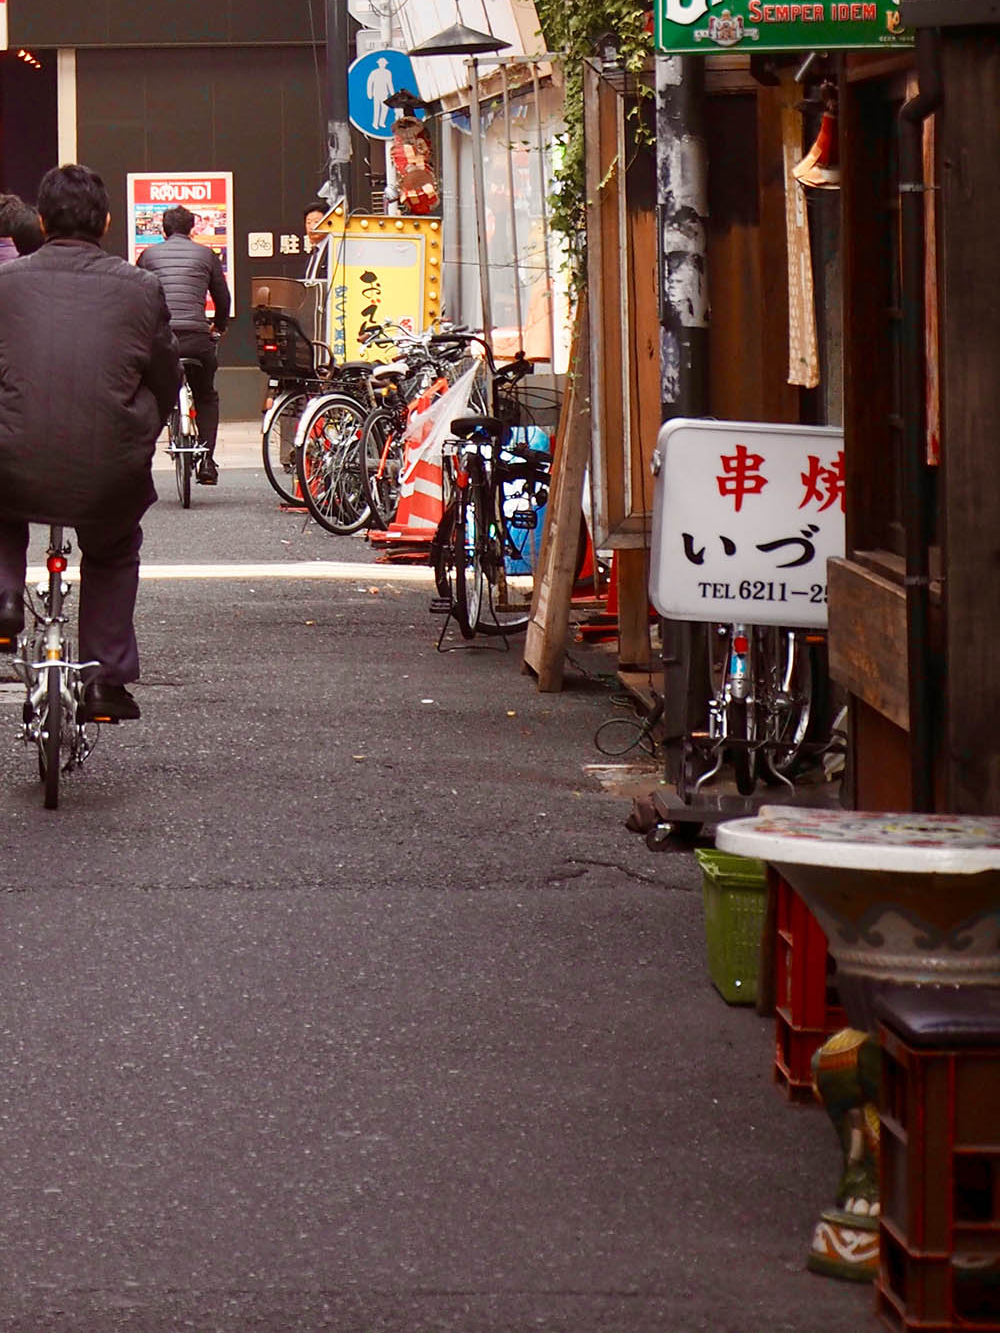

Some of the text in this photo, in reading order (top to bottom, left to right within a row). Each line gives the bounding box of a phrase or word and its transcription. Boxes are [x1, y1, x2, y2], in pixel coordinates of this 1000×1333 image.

[749, 0, 877, 23] SEMPER IDEM
[698, 582, 735, 599] TEL
